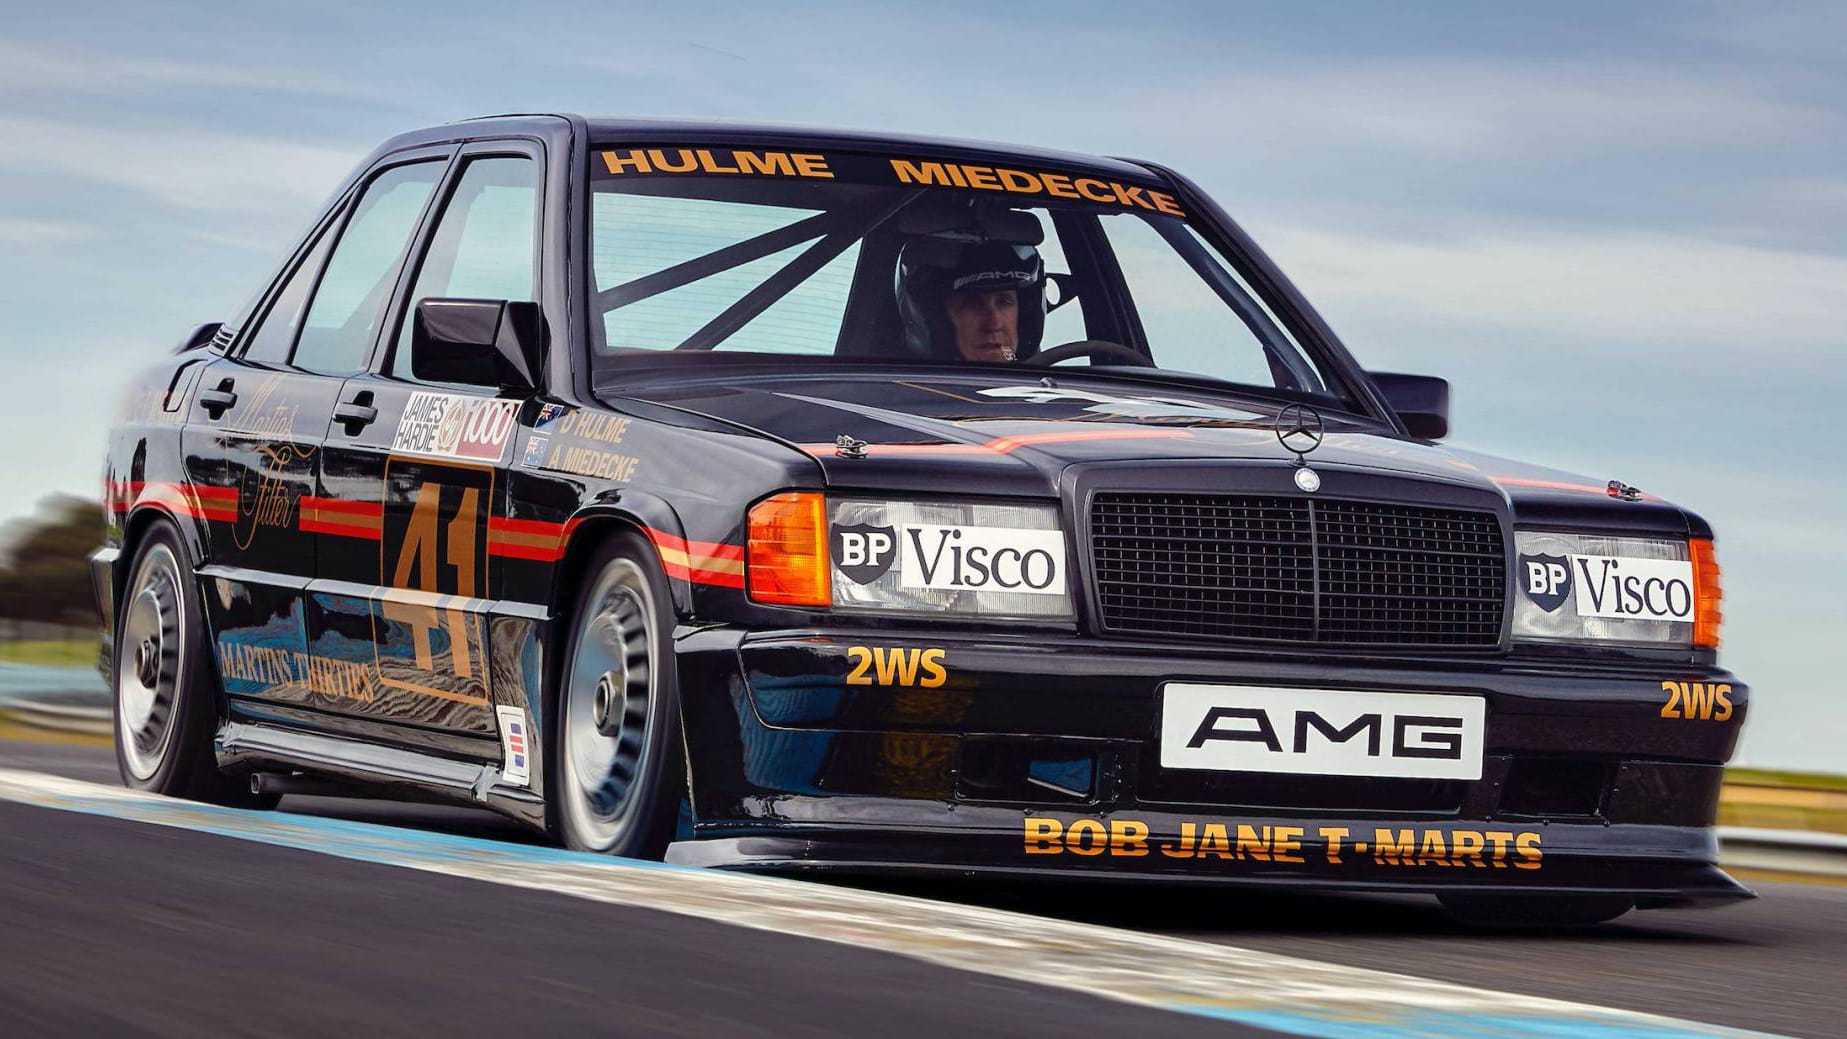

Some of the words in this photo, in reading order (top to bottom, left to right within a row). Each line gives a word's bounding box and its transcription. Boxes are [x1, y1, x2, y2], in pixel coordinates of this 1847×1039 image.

[600, 149, 834, 178] HULME
[889, 159, 1186, 217] MIEDECKE
[977, 271, 1032, 281] AMG
[404, 395, 448, 421] JAMES
[462, 400, 516, 446] 1000
[560, 410, 579, 435] D
[574, 411, 632, 444] HULME
[395, 421, 439, 451] HARDIE
[562, 448, 640, 482] MIEDECKE
[384, 482, 479, 678] 41
[840, 532, 891, 567] BP
[907, 528, 1055, 589] Visco
[1526, 561, 1567, 596] BP
[1577, 558, 1691, 617] Visco
[218, 641, 292, 688] MARTINS
[294, 652, 374, 703] THIRTIES
[846, 646, 947, 688] 2WS
[1660, 680, 1733, 721] 2WS
[1186, 706, 1463, 760] AMG
[1023, 817, 1150, 857] BOB
[1162, 822, 1304, 863] JANE
